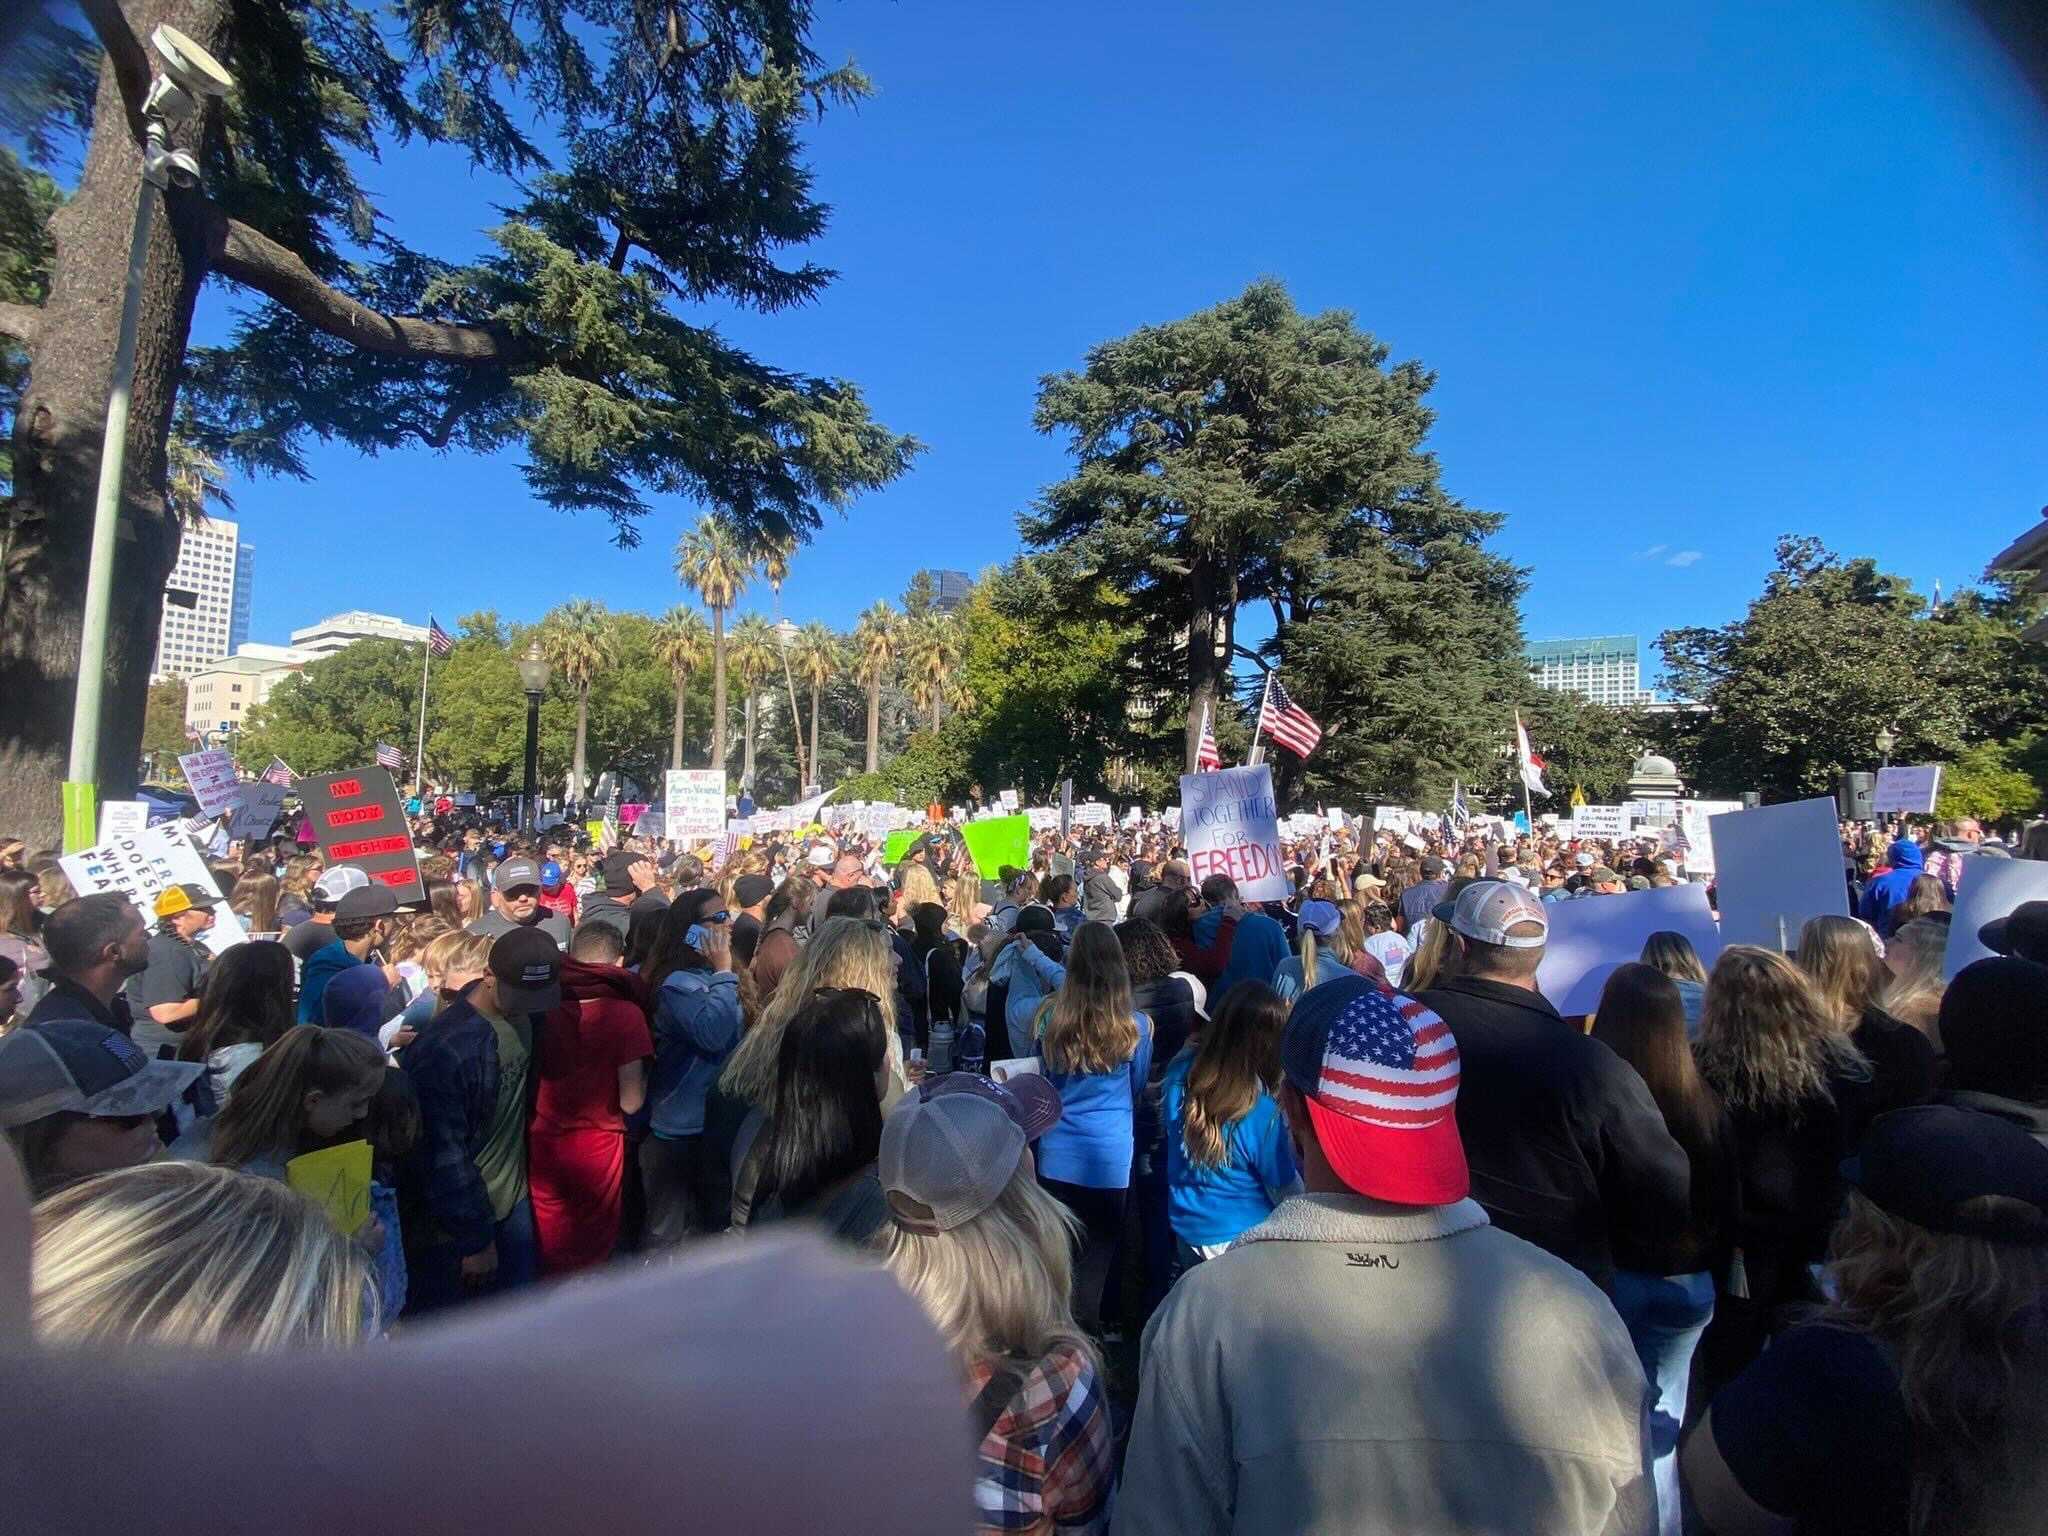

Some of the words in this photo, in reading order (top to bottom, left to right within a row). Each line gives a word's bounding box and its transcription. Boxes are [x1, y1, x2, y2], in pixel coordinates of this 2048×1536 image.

[332, 782, 357, 796] MY
[1191, 771, 1260, 802] STAND
[331, 807, 379, 824] BODY
[1194, 796, 1277, 827] TOGETHER
[160, 825, 187, 847] MY
[1211, 827, 1249, 849] FOR
[333, 838, 406, 858] RIGHTS
[79, 851, 112, 890] FEA
